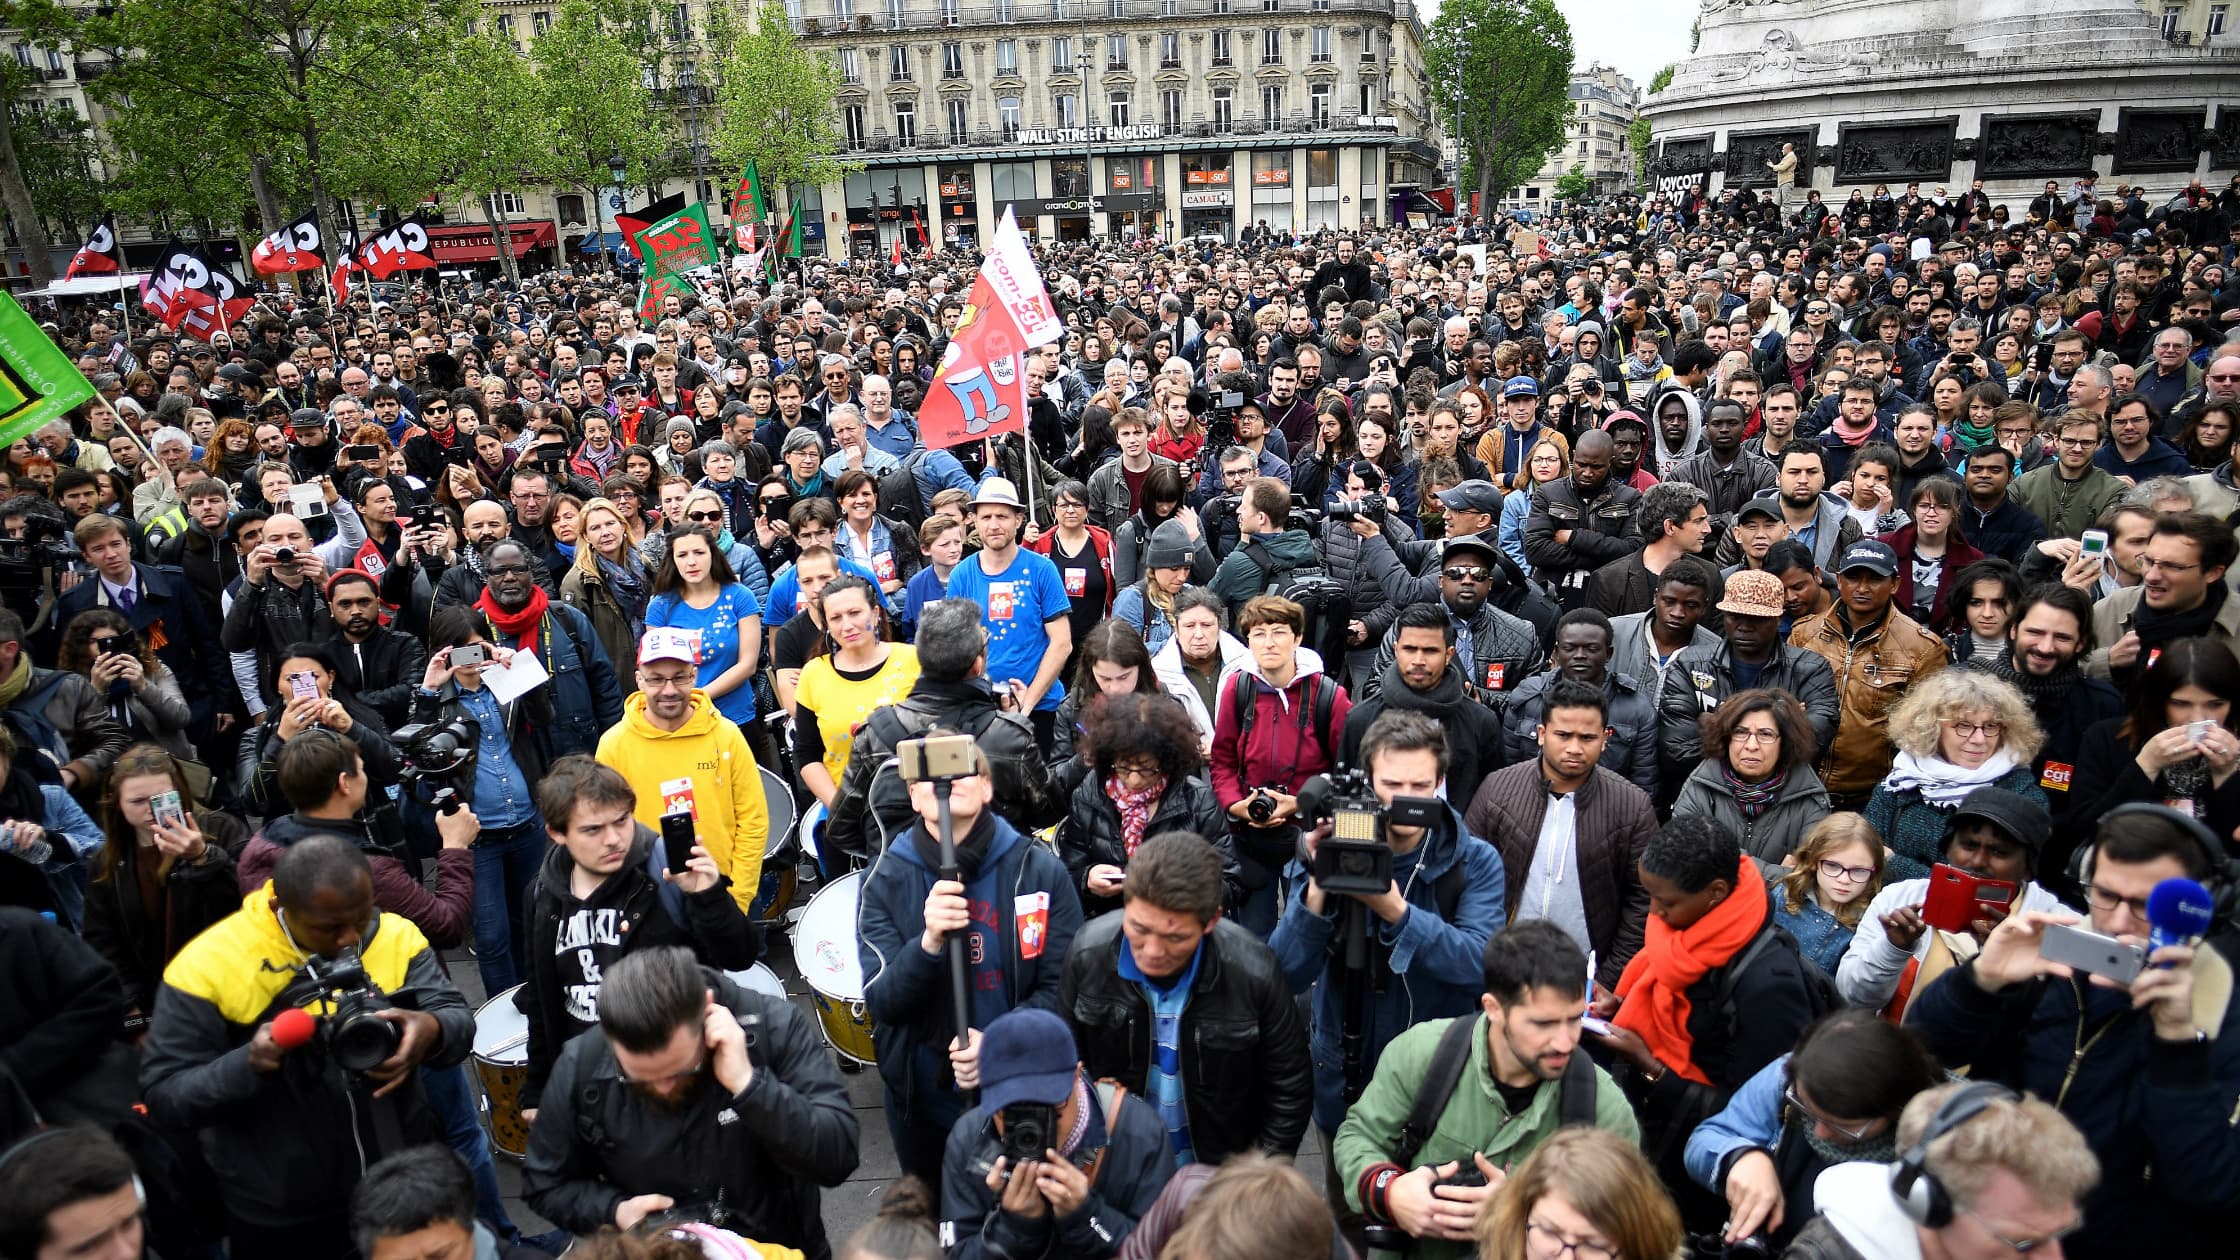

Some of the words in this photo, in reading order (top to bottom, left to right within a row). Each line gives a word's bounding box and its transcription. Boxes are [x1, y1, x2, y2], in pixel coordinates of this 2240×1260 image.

[1016, 129, 1052, 145] WALL
[1057, 127, 1101, 143] STREET
[1106, 125, 1160, 141] ENGLISH
[1659, 173, 1704, 191] BOYCOTT
[1487, 669, 1503, 680] cgt
[2043, 769, 2071, 783] cgt
[578, 948, 604, 983] &
